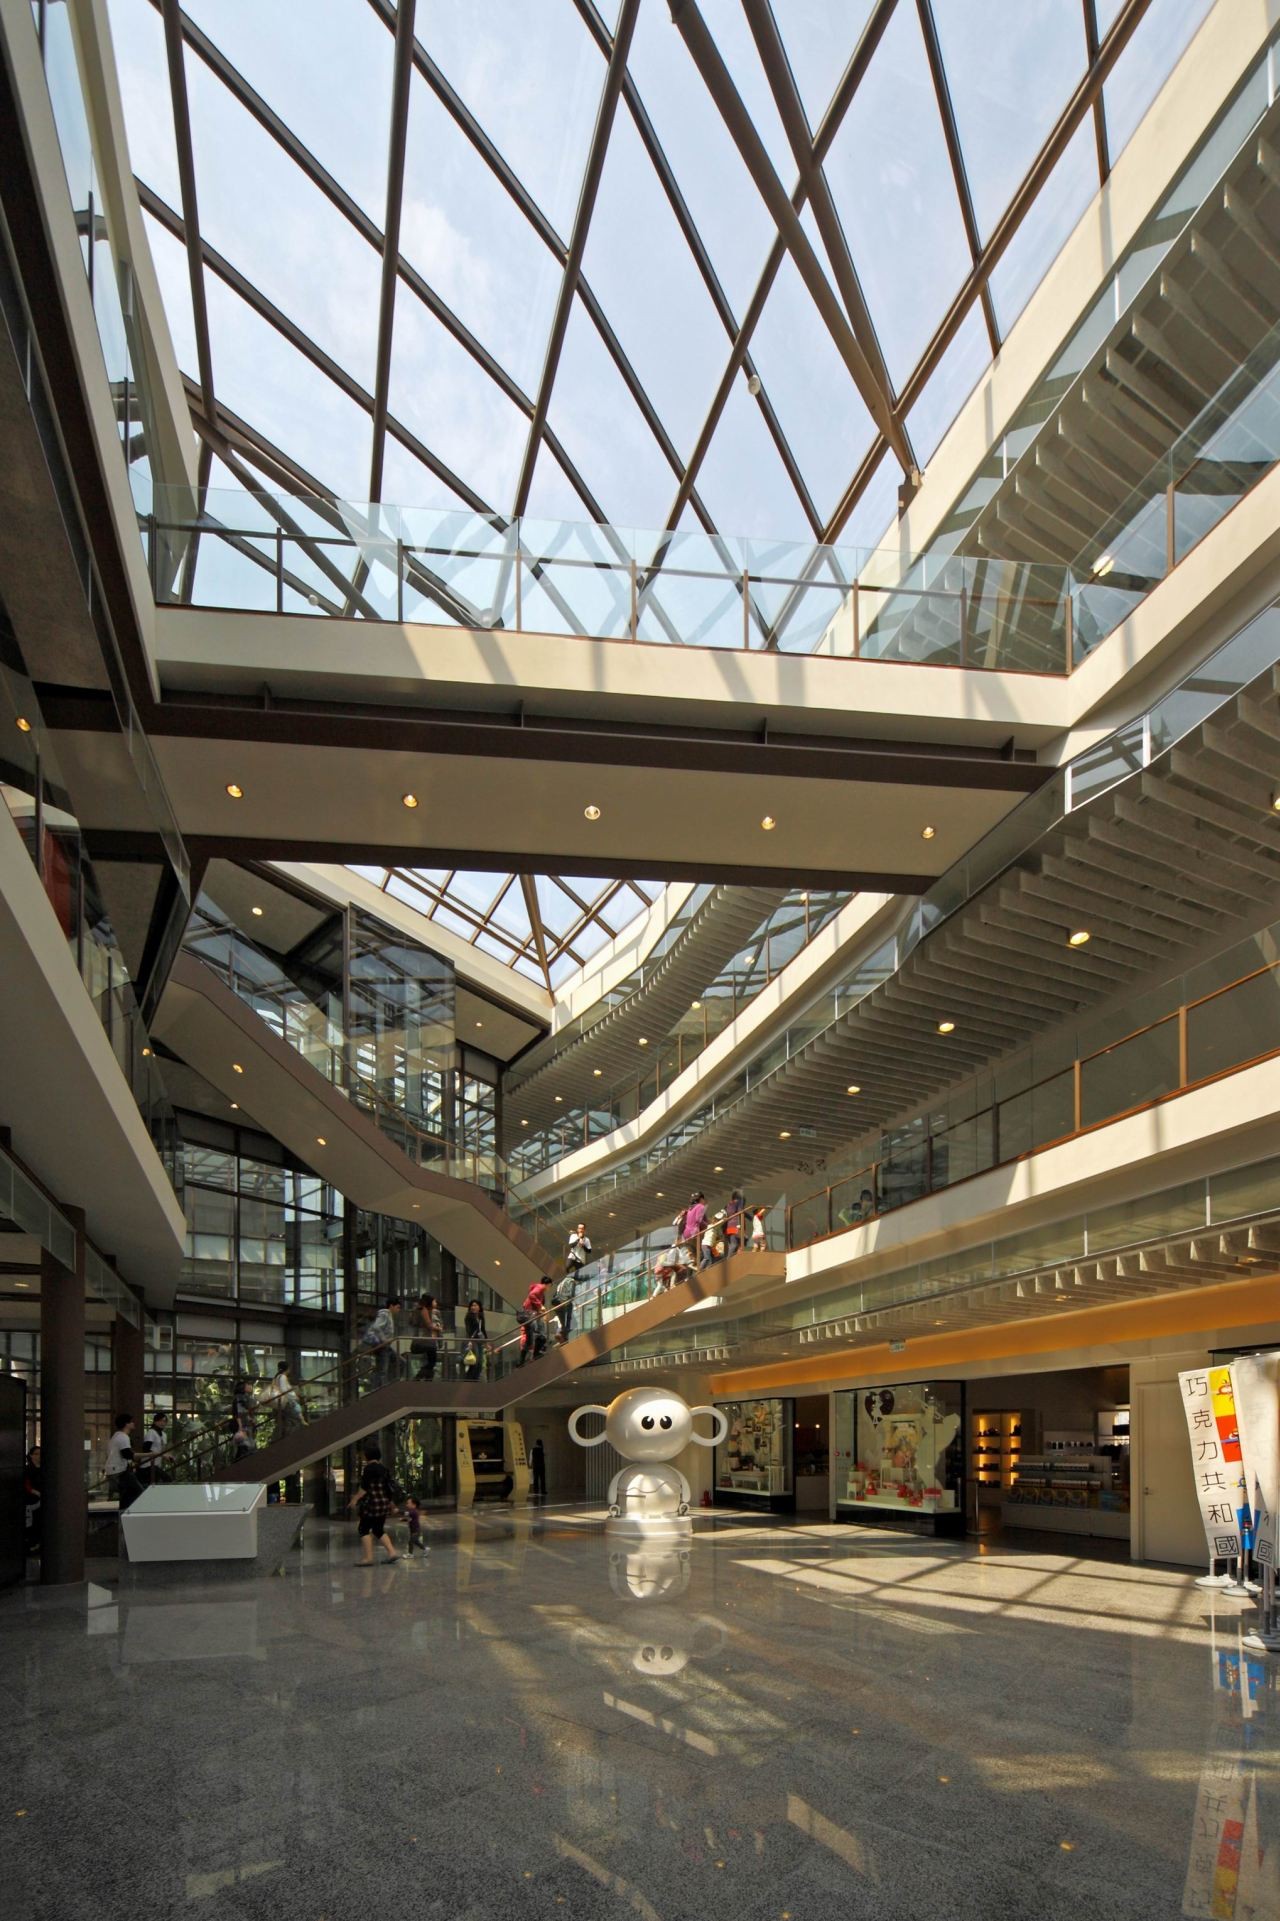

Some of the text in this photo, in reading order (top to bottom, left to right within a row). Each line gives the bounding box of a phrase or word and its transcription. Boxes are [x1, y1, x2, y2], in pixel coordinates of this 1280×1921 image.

[1186, 1376, 1239, 1556] 巧克力共和國
